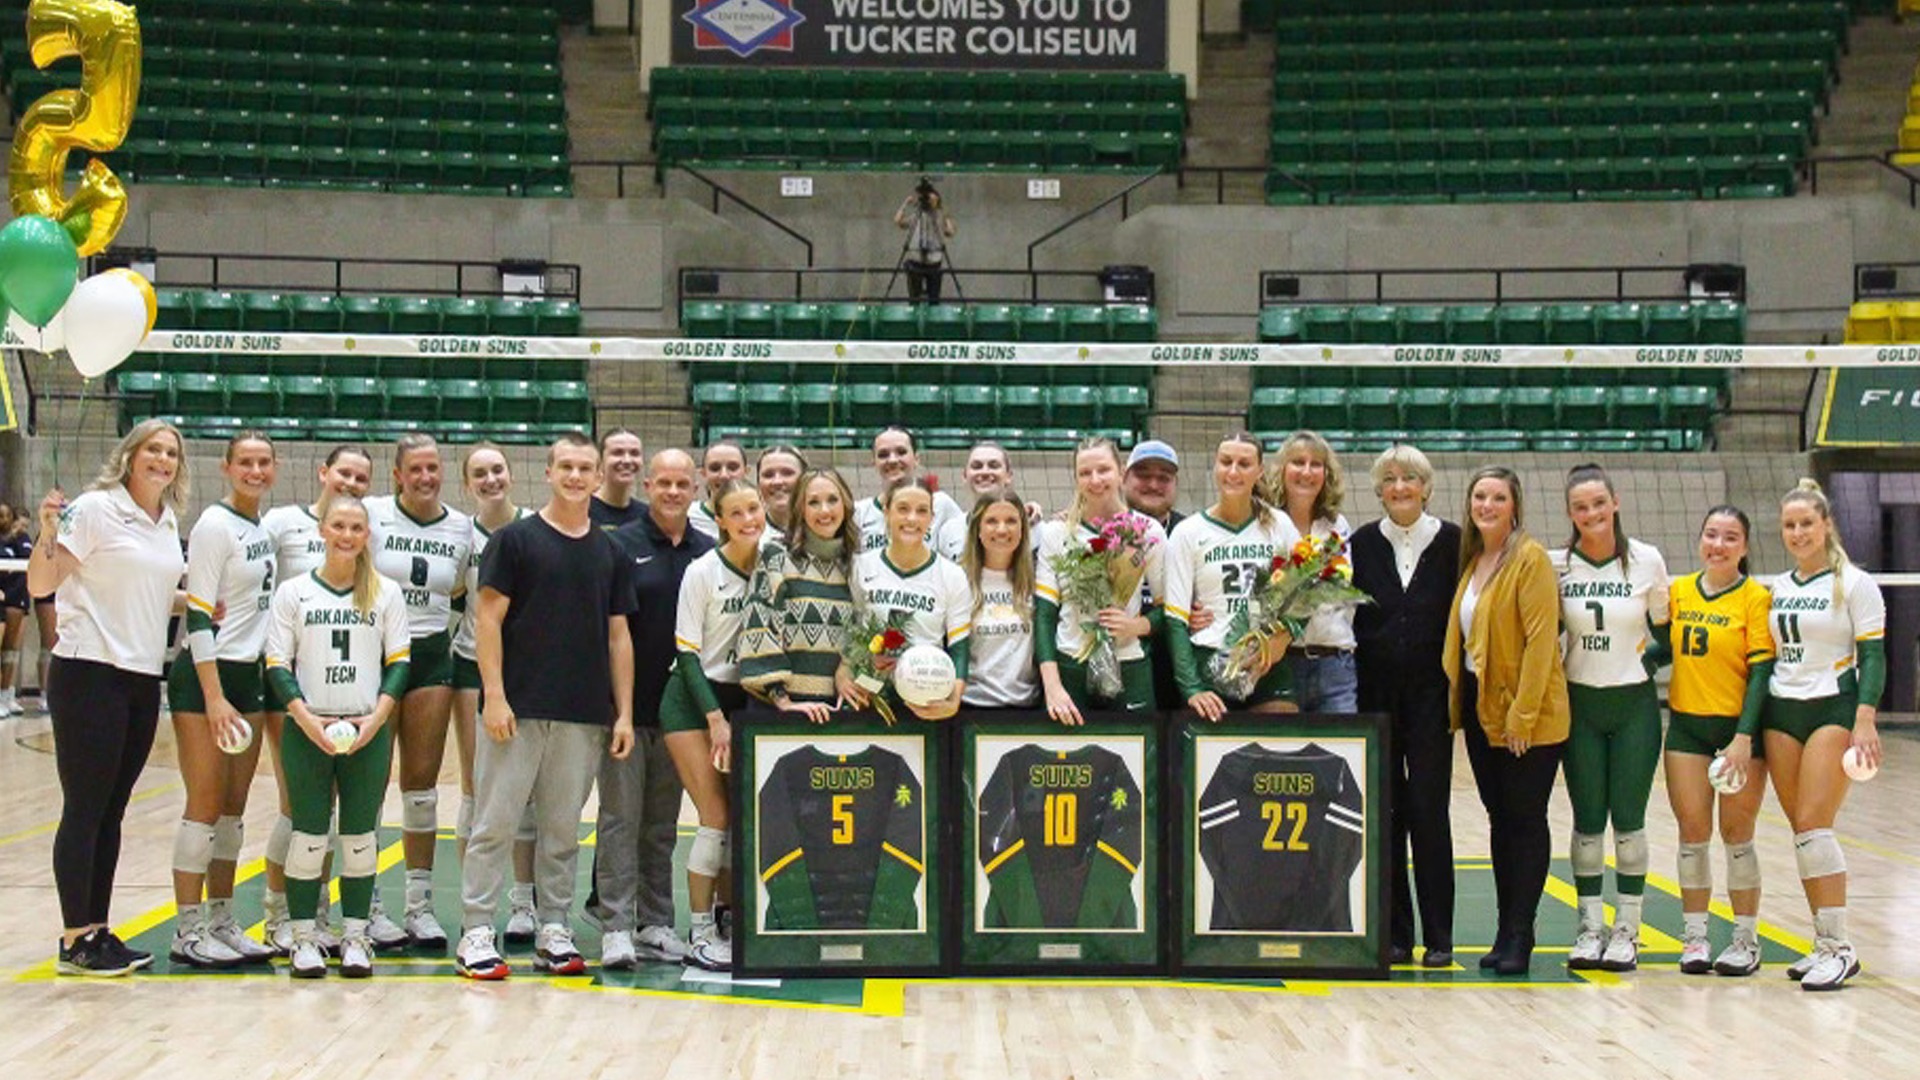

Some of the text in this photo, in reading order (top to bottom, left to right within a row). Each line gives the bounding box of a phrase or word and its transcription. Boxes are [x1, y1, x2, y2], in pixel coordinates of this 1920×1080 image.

[833, 0, 1005, 20] WELCOMES
[1016, 0, 1078, 20] YOU
[824, 25, 1137, 55] TUCKER COLISEUM
[172, 334, 282, 350] GOLDEN SUNS
[418, 339, 527, 354] GOLDEN SUNS
[663, 342, 772, 357] GOLDEN SUNS
[907, 345, 1016, 359] GOLDEN SUNS
[1151, 346, 1259, 361] GOLDEN SUNS
[1394, 348, 1502, 363] GOLDEN SUNS
[1636, 348, 1744, 363] GOLDEN SUNS
[385, 535, 456, 558] ARKANSAS
[1205, 544, 1274, 563] ARKANSAS
[1564, 582, 1632, 598] ARKANSAS
[868, 589, 936, 613] ARKANSAS
[304, 608, 377, 627] ARKANSAS
[1585, 601, 1604, 631] 7
[1778, 613, 1802, 644] 11
[332, 629, 350, 661] 4
[1582, 635, 1610, 651] TECH
[1682, 624, 1709, 657] 13
[325, 665, 356, 684] TECH
[810, 767, 875, 789] SUNS
[1029, 764, 1093, 788] SUNS
[1254, 772, 1314, 795] SUNS
[832, 795, 853, 844] 5
[1043, 793, 1077, 846] 10
[1262, 801, 1309, 850] 22
